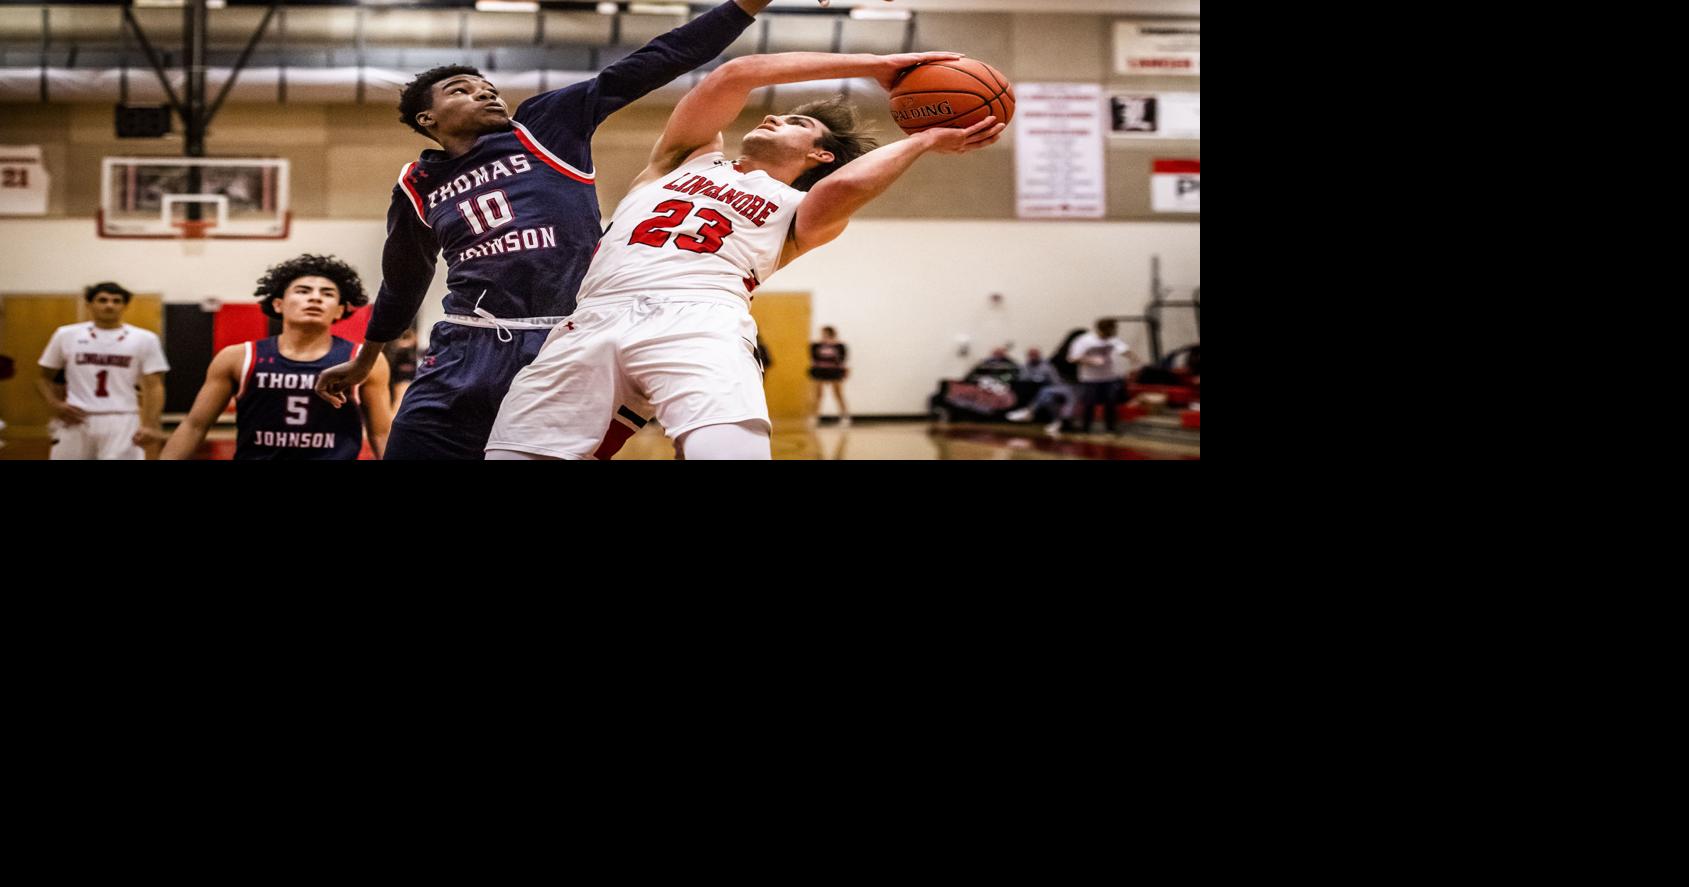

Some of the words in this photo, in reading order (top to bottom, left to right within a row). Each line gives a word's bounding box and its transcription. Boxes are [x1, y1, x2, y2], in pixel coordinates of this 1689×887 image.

[2, 167, 29, 188] 21
[427, 153, 533, 209] THOMAS
[456, 188, 516, 235] 10
[626, 198, 735, 254] 23
[95, 369, 110, 398] 1
[255, 371, 317, 390] THOM
[285, 395, 310, 425] 5
[254, 430, 336, 449] JOHNSON
